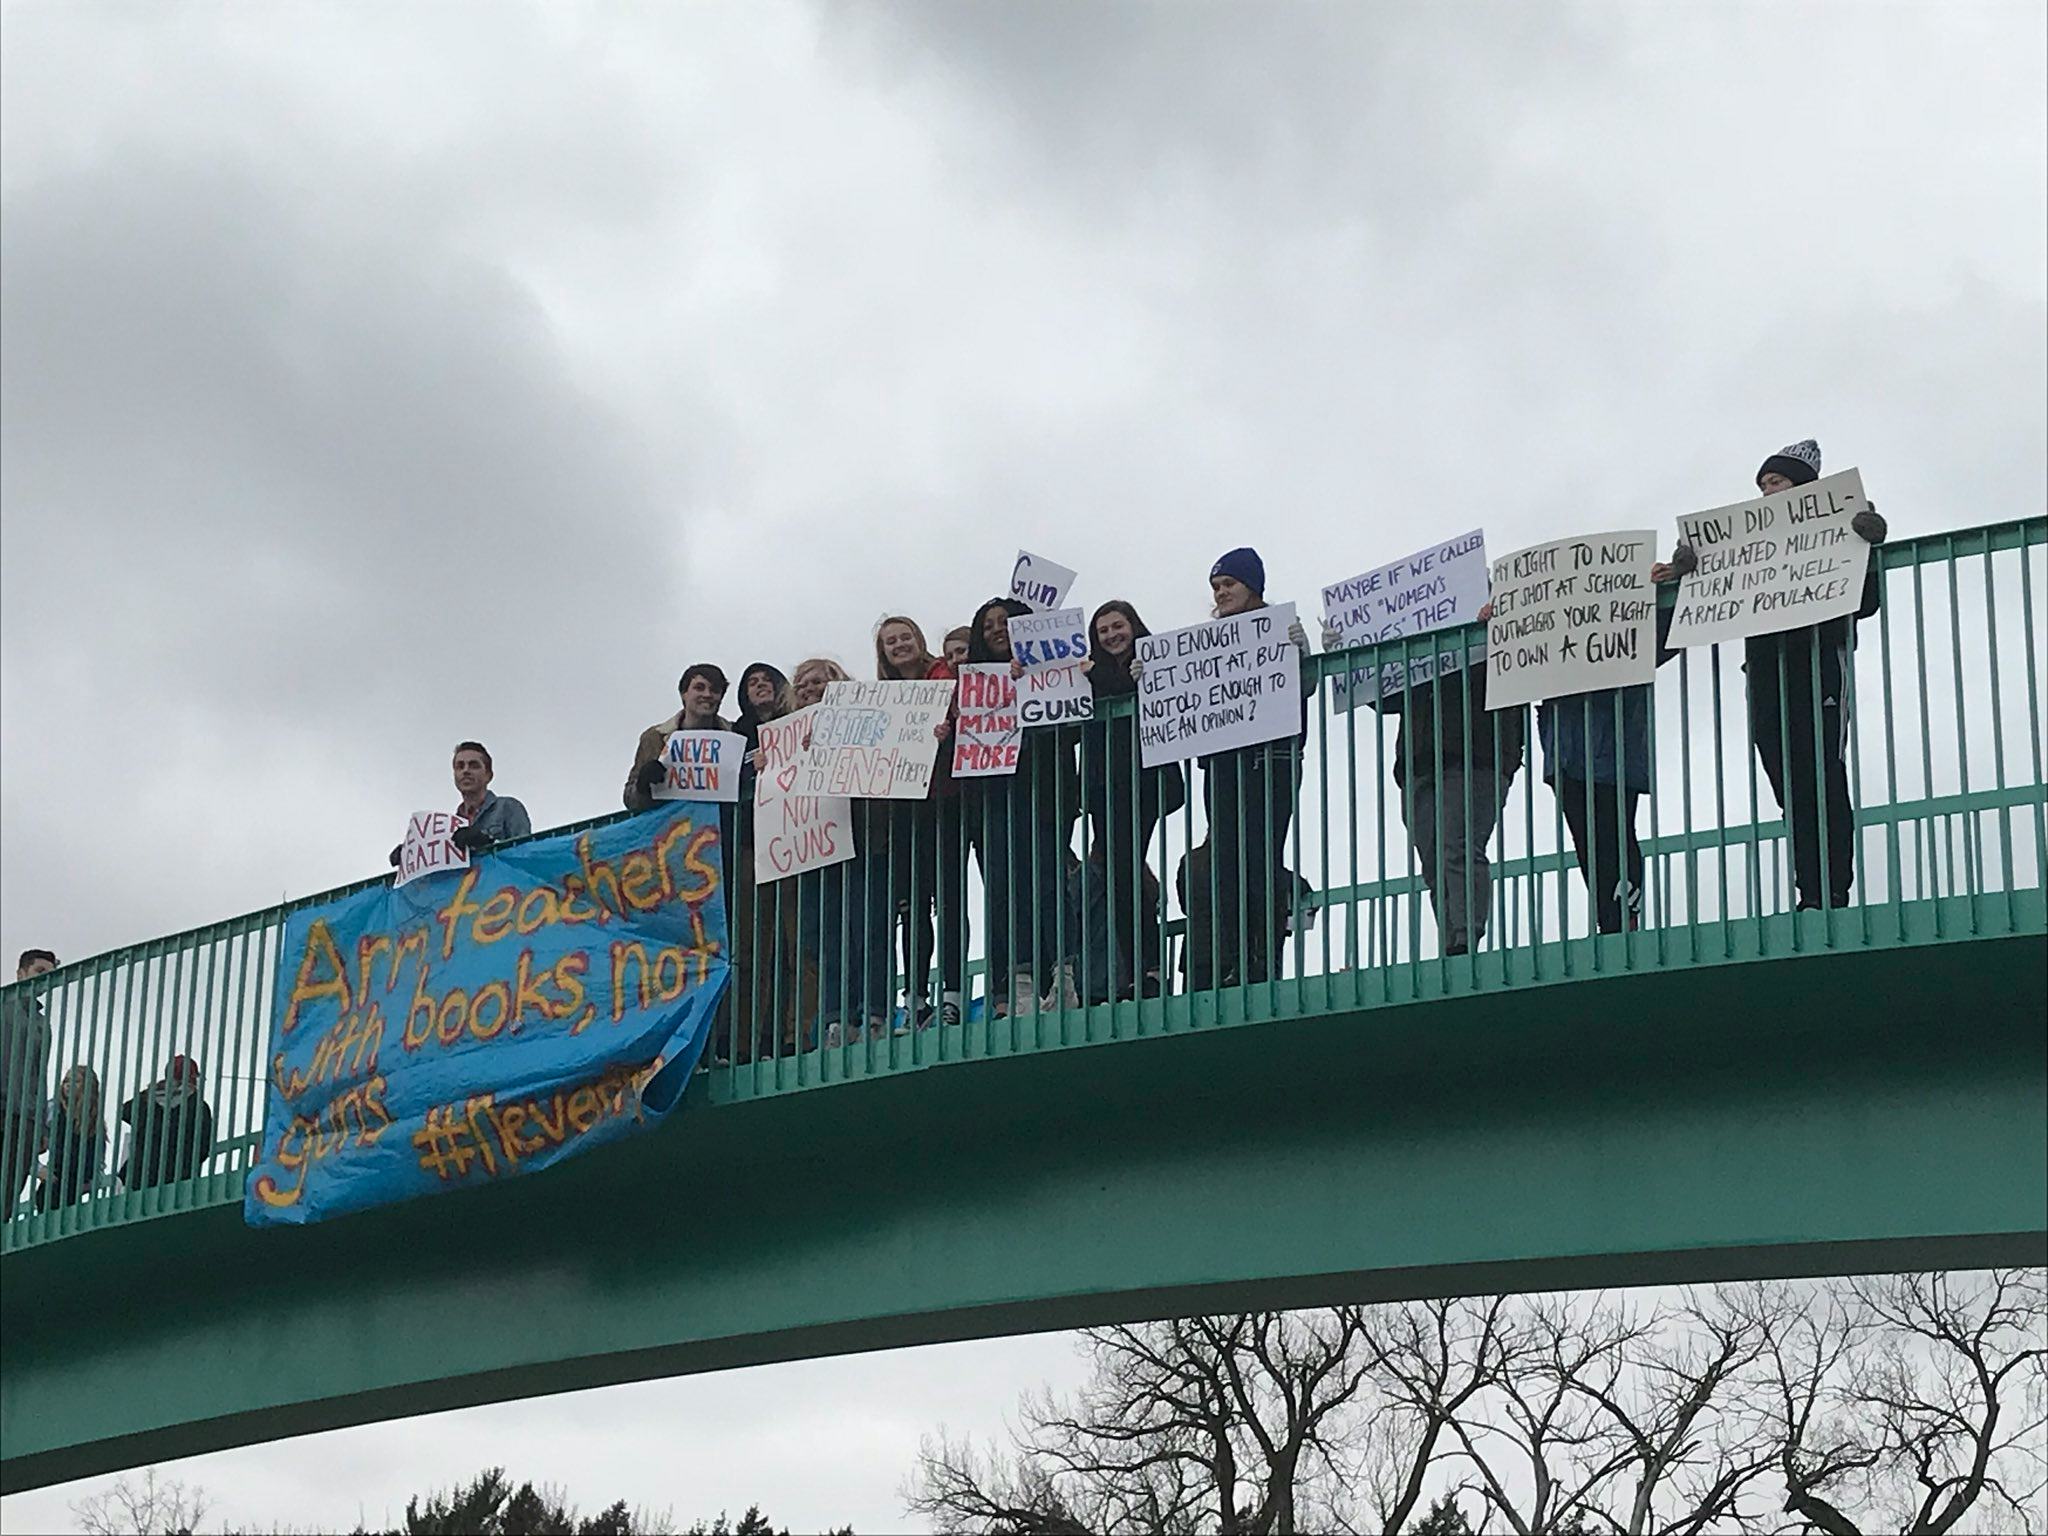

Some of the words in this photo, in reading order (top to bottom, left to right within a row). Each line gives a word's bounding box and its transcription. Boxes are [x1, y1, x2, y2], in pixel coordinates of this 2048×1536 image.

[1684, 516, 1733, 548] HOW
[1745, 506, 1775, 534] DID
[1787, 491, 1854, 525] WELL-
[1785, 526, 1849, 555] MILITIA
[1011, 555, 1058, 607] Gun
[1324, 573, 1381, 606] MAYBE
[1388, 565, 1404, 586] IF
[1410, 553, 1435, 577] WE
[1439, 535, 1484, 564] CALLED
[1493, 562, 1509, 582] MY
[1514, 547, 1559, 578] RIGHT
[1569, 543, 1593, 570] TO
[1601, 543, 1644, 565] NOT
[1686, 573, 1734, 598] TURN
[1741, 566, 1777, 591] INTO
[1412, 596, 1457, 630] THEY
[1490, 589, 1519, 618] GET
[1520, 579, 1554, 607] SHOT
[1555, 576, 1577, 598] AT
[1584, 573, 1644, 593] SCHOOL
[1752, 577, 1850, 614] POPULACE?
[1011, 612, 1082, 635] PROTECT
[1330, 603, 1371, 634] GUNS
[1492, 610, 1555, 646] OUTWEIGHS
[1564, 603, 1600, 629] YOUR
[1610, 600, 1655, 623] RIGHT
[1014, 632, 1088, 667] KIDS
[1141, 639, 1170, 663] OLD
[1177, 621, 1240, 657] ENOUGH
[1251, 617, 1271, 639] TO
[1490, 650, 1511, 676] TO
[1517, 642, 1548, 668] OWN
[1559, 635, 1578, 663] A
[1586, 627, 1637, 663] GUN!
[1031, 664, 1078, 692] NOT
[1142, 665, 1177, 695] GET
[1180, 655, 1223, 684] SHOT
[1226, 650, 1252, 671] AT,
[1256, 642, 1291, 667] BUT
[1021, 695, 1093, 723] GUNS
[1142, 696, 1176, 721] NOT
[1176, 691, 1201, 714] OLD
[1209, 675, 1262, 707] ENOUGH
[1268, 672, 1286, 692] TO
[813, 708, 892, 747] BETTER
[1141, 718, 1177, 747] HAVE
[1178, 714, 1197, 740] AN
[670, 738, 721, 763] NEVER
[809, 747, 836, 767] NOT
[955, 743, 1018, 771] MORE
[668, 766, 719, 790] AGAIN
[808, 769, 824, 791] TO
[396, 839, 467, 885] AGAIN
[769, 821, 838, 873] GUNS
[437, 818, 720, 961] teachers
[272, 1002, 386, 1100] with
[402, 948, 596, 1054] books,
[609, 902, 722, 1023] not
[256, 1074, 395, 1207] guns
